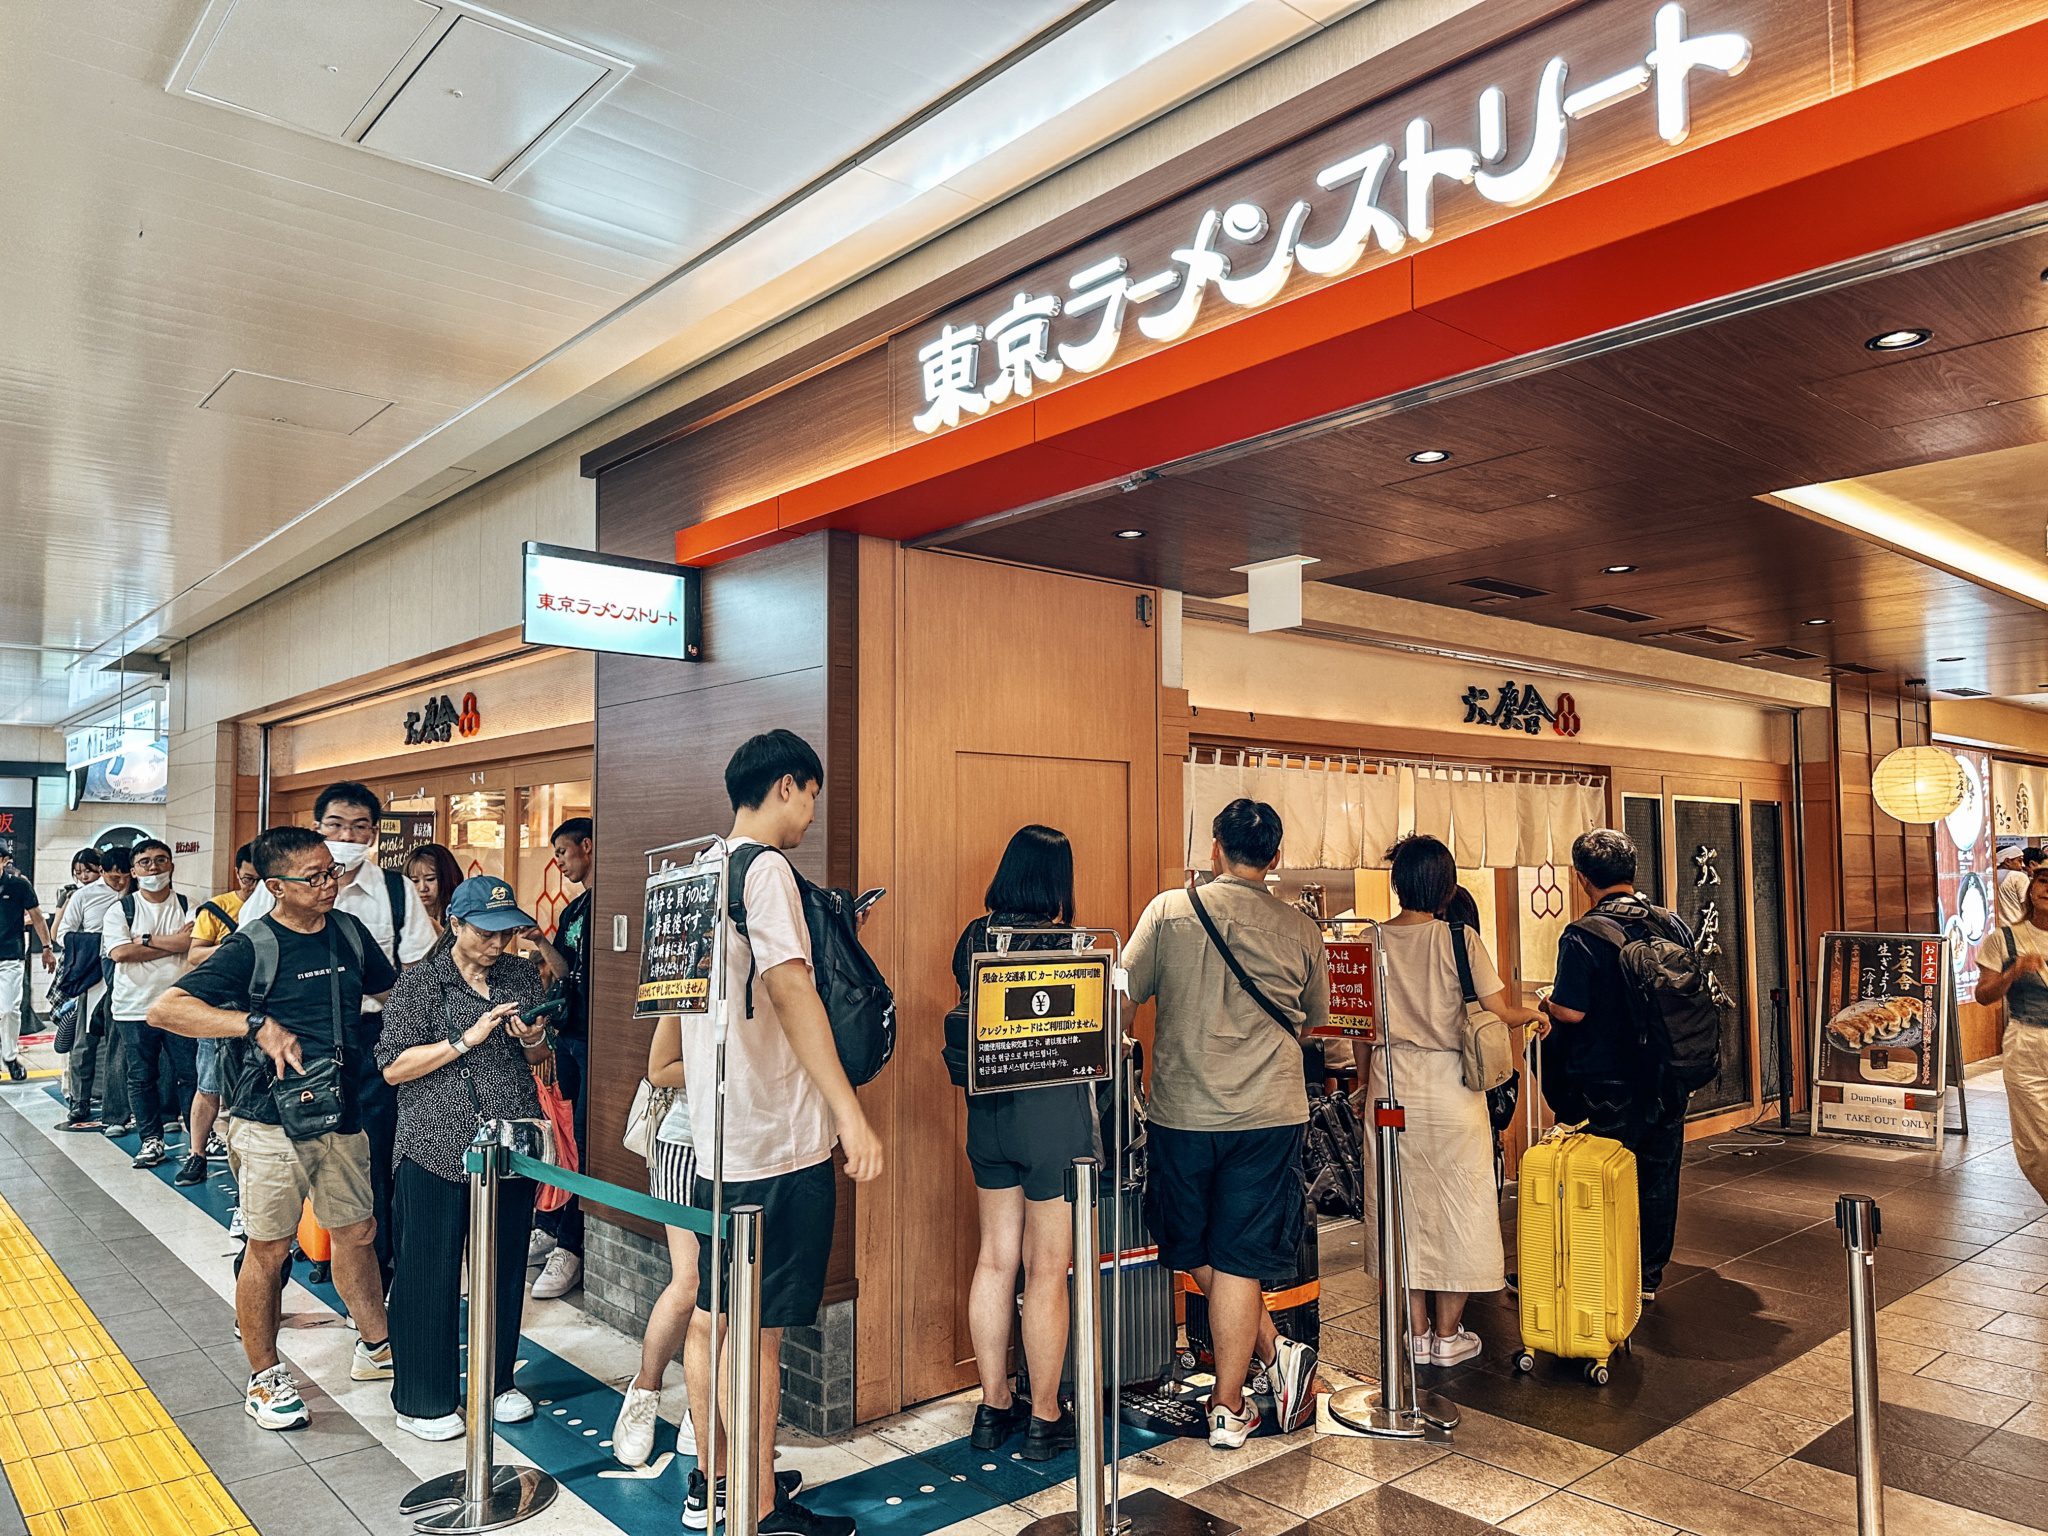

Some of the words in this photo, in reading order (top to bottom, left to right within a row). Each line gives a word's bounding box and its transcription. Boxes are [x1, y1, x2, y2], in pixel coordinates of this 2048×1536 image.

[913, 2, 1753, 434] 東京ラーメンストリート
[536, 593, 678, 626] 東京ラーメンストリート
[1923, 944, 1938, 980] お土産
[1876, 942, 1894, 1009] 生ぎょうざ
[1328, 997, 1372, 1009] 待ち下さい
[1851, 1092, 1897, 1105] Dumplings
[1824, 1112, 1837, 1120] are
[1844, 1112, 1871, 1123] TAKE
[1874, 1115, 1898, 1126] OUT
[1901, 1119, 1931, 1130] ONLY
